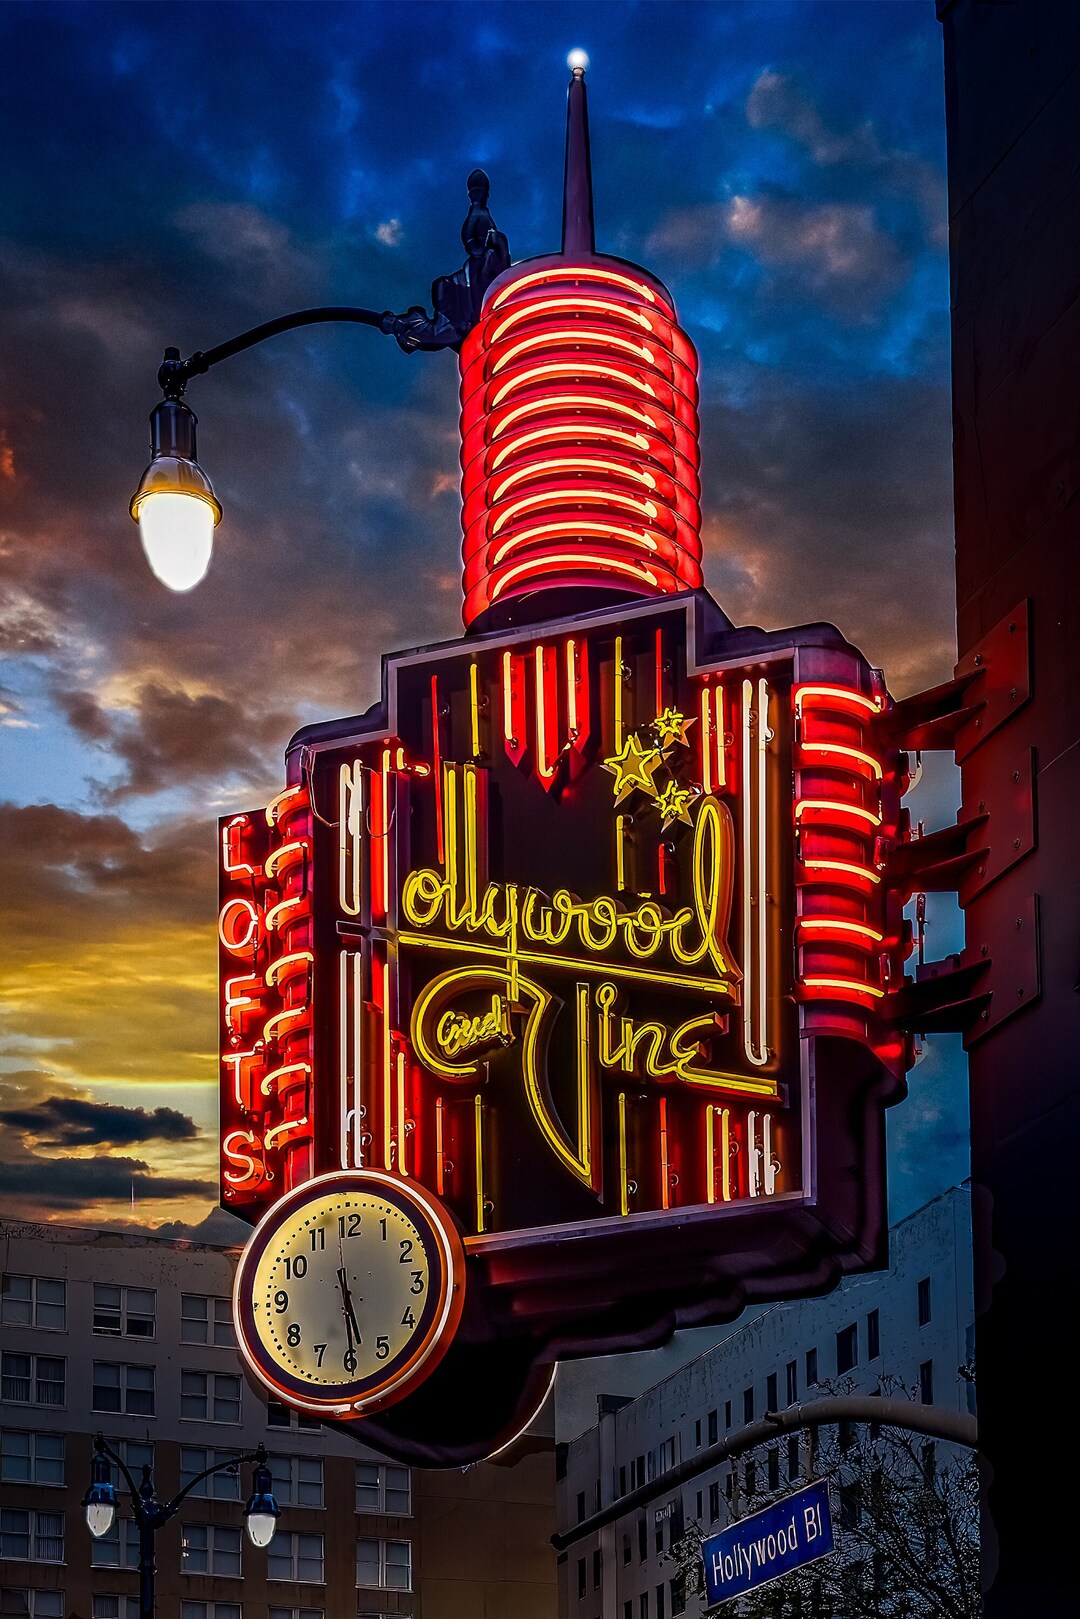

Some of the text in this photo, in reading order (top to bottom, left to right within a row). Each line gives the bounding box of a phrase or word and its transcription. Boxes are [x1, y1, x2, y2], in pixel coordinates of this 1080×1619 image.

[217, 814, 268, 1192] LOFTS
[409, 965, 780, 1204] Vine
[338, 1213, 361, 1239] 12
[379, 1218, 388, 1241] 1
[309, 1227, 325, 1251] 11
[399, 1239, 413, 1264] 2
[283, 1254, 308, 1280] 10
[410, 1270, 424, 1295] 3
[274, 1290, 289, 1314] 9
[401, 1306, 416, 1329] 4
[287, 1323, 301, 1348] 8
[375, 1335, 390, 1360] 5
[313, 1343, 328, 1367] 7
[343, 1348, 358, 1374] 6
[712, 1502, 823, 1586] Hollywood Bl
